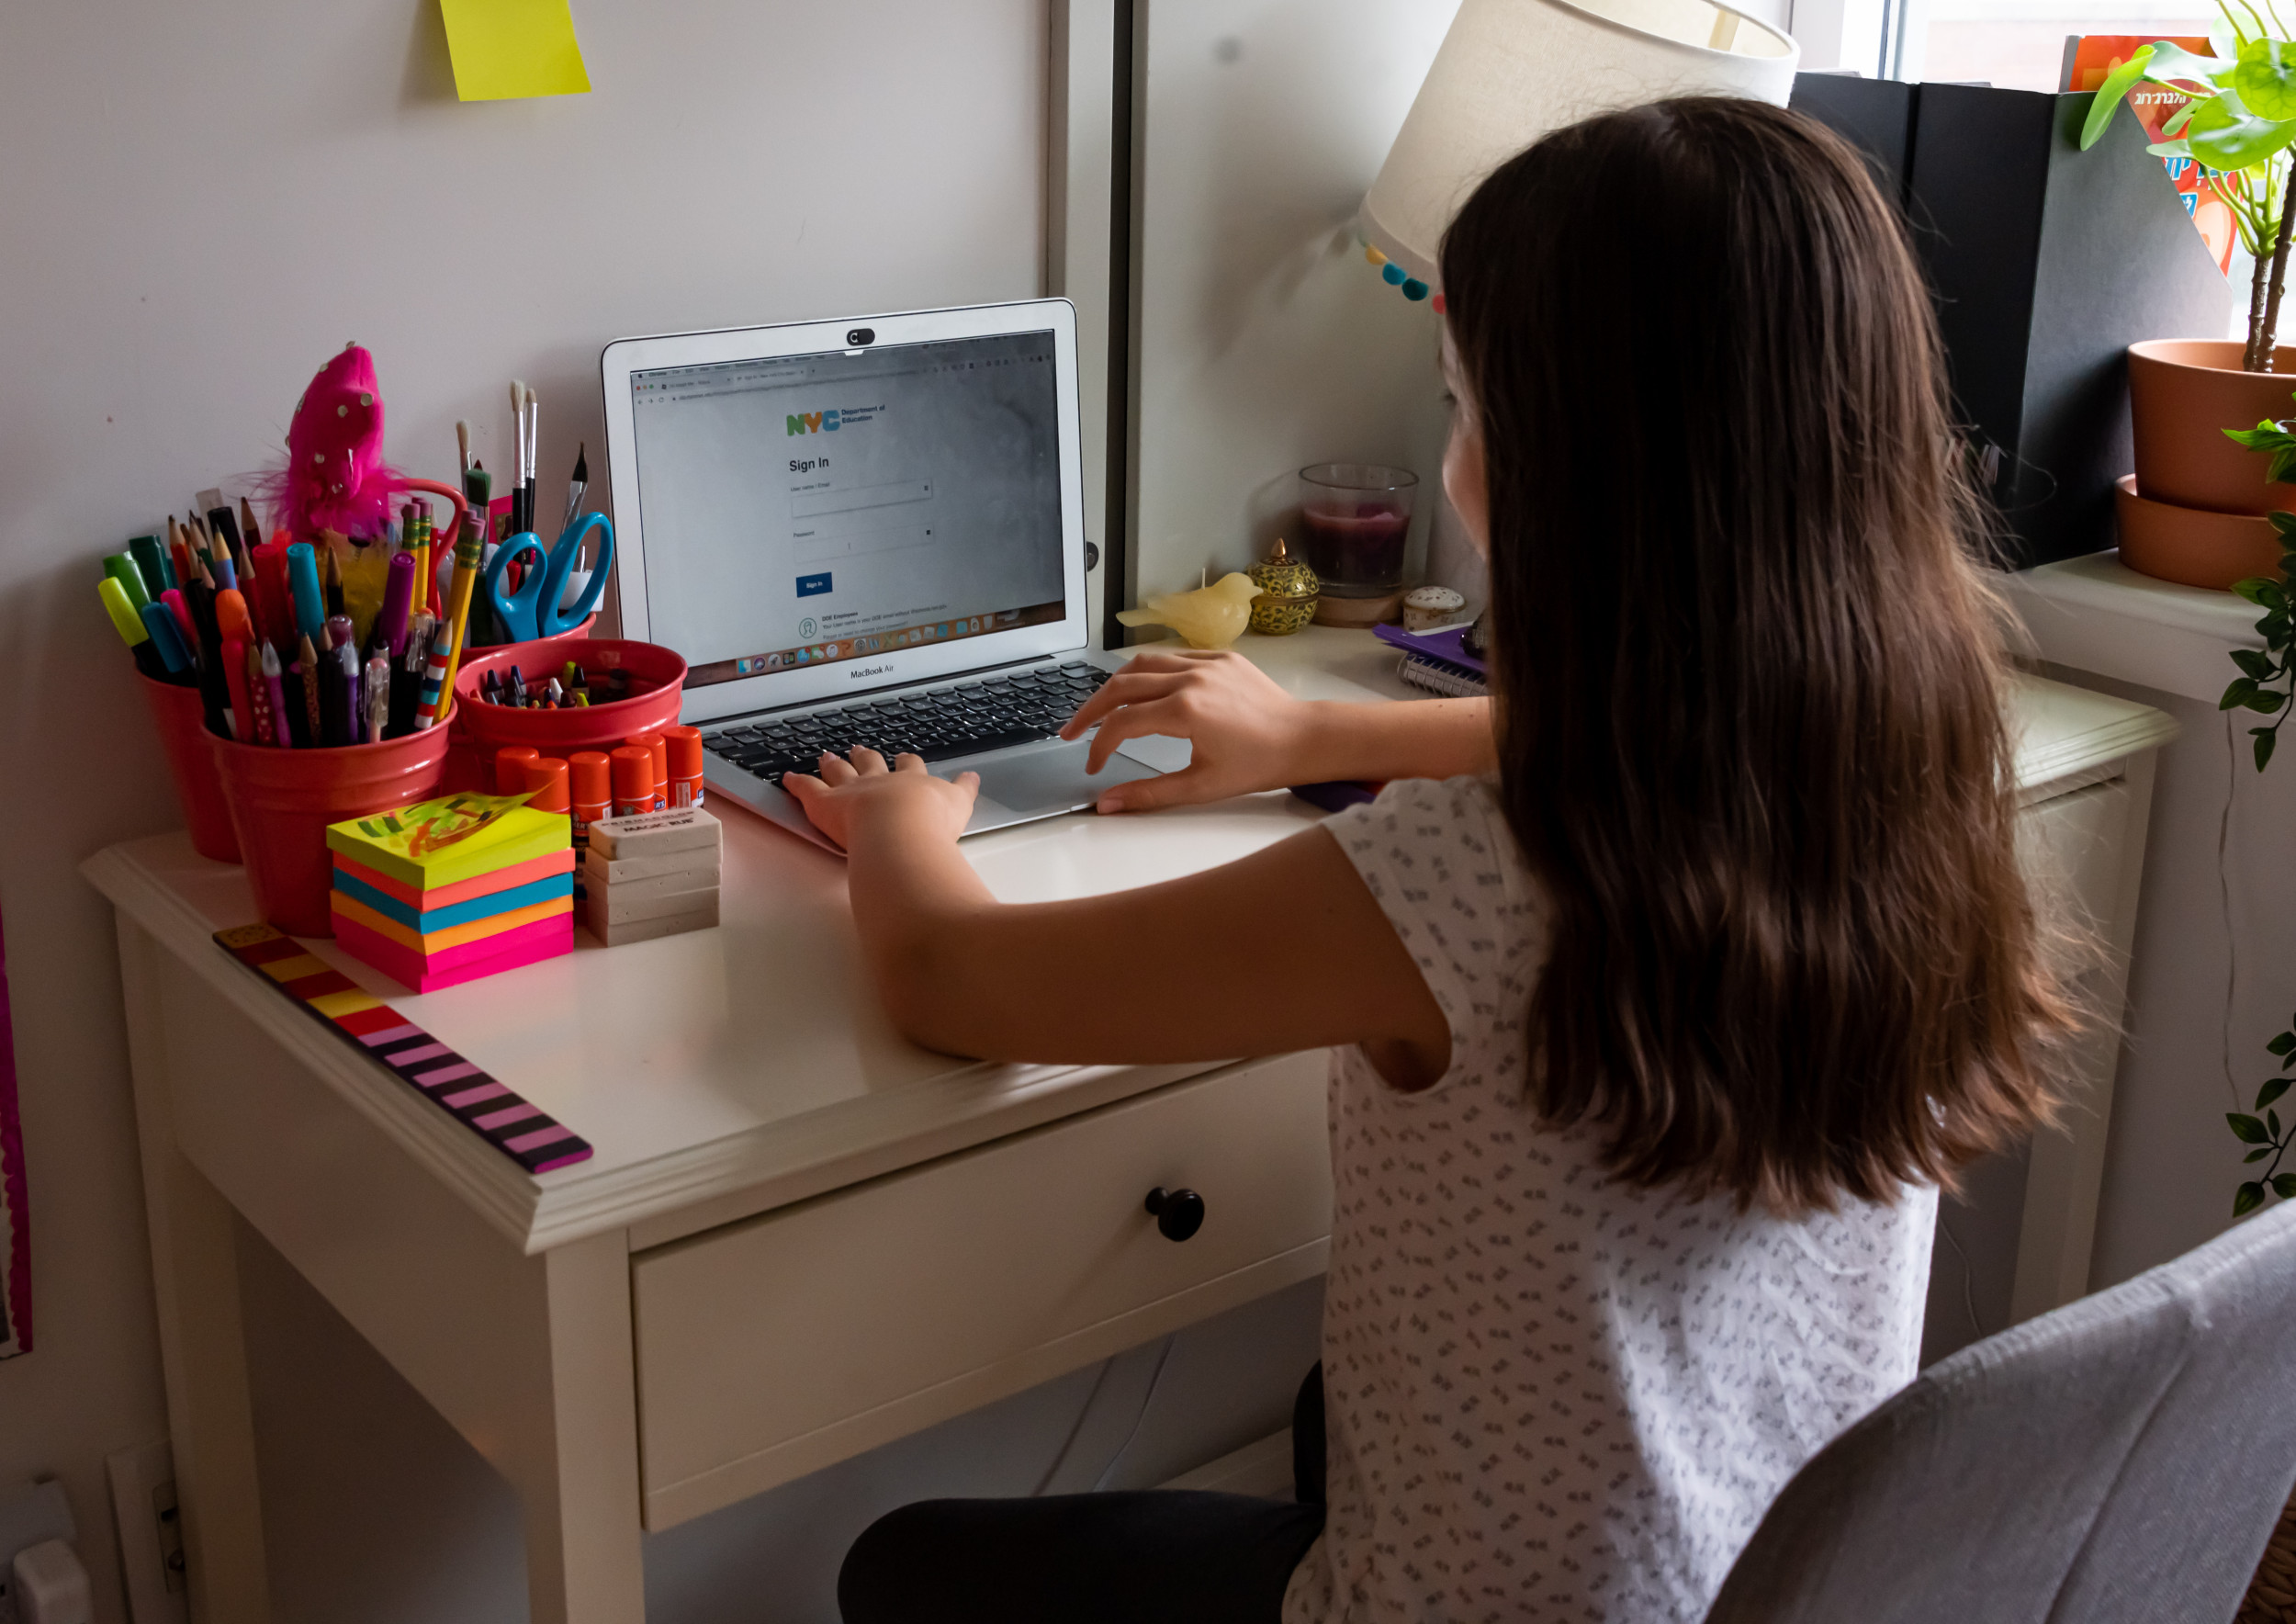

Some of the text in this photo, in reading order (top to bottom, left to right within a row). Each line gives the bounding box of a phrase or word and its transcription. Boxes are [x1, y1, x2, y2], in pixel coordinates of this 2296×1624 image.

[841, 406, 878, 416] Department
[786, 410, 840, 436] NYC
[841, 415, 873, 423] Education
[789, 457, 829, 473] Sign In
[850, 664, 895, 679] MacBook Air
[624, 817, 694, 833] MAGIC RUB
